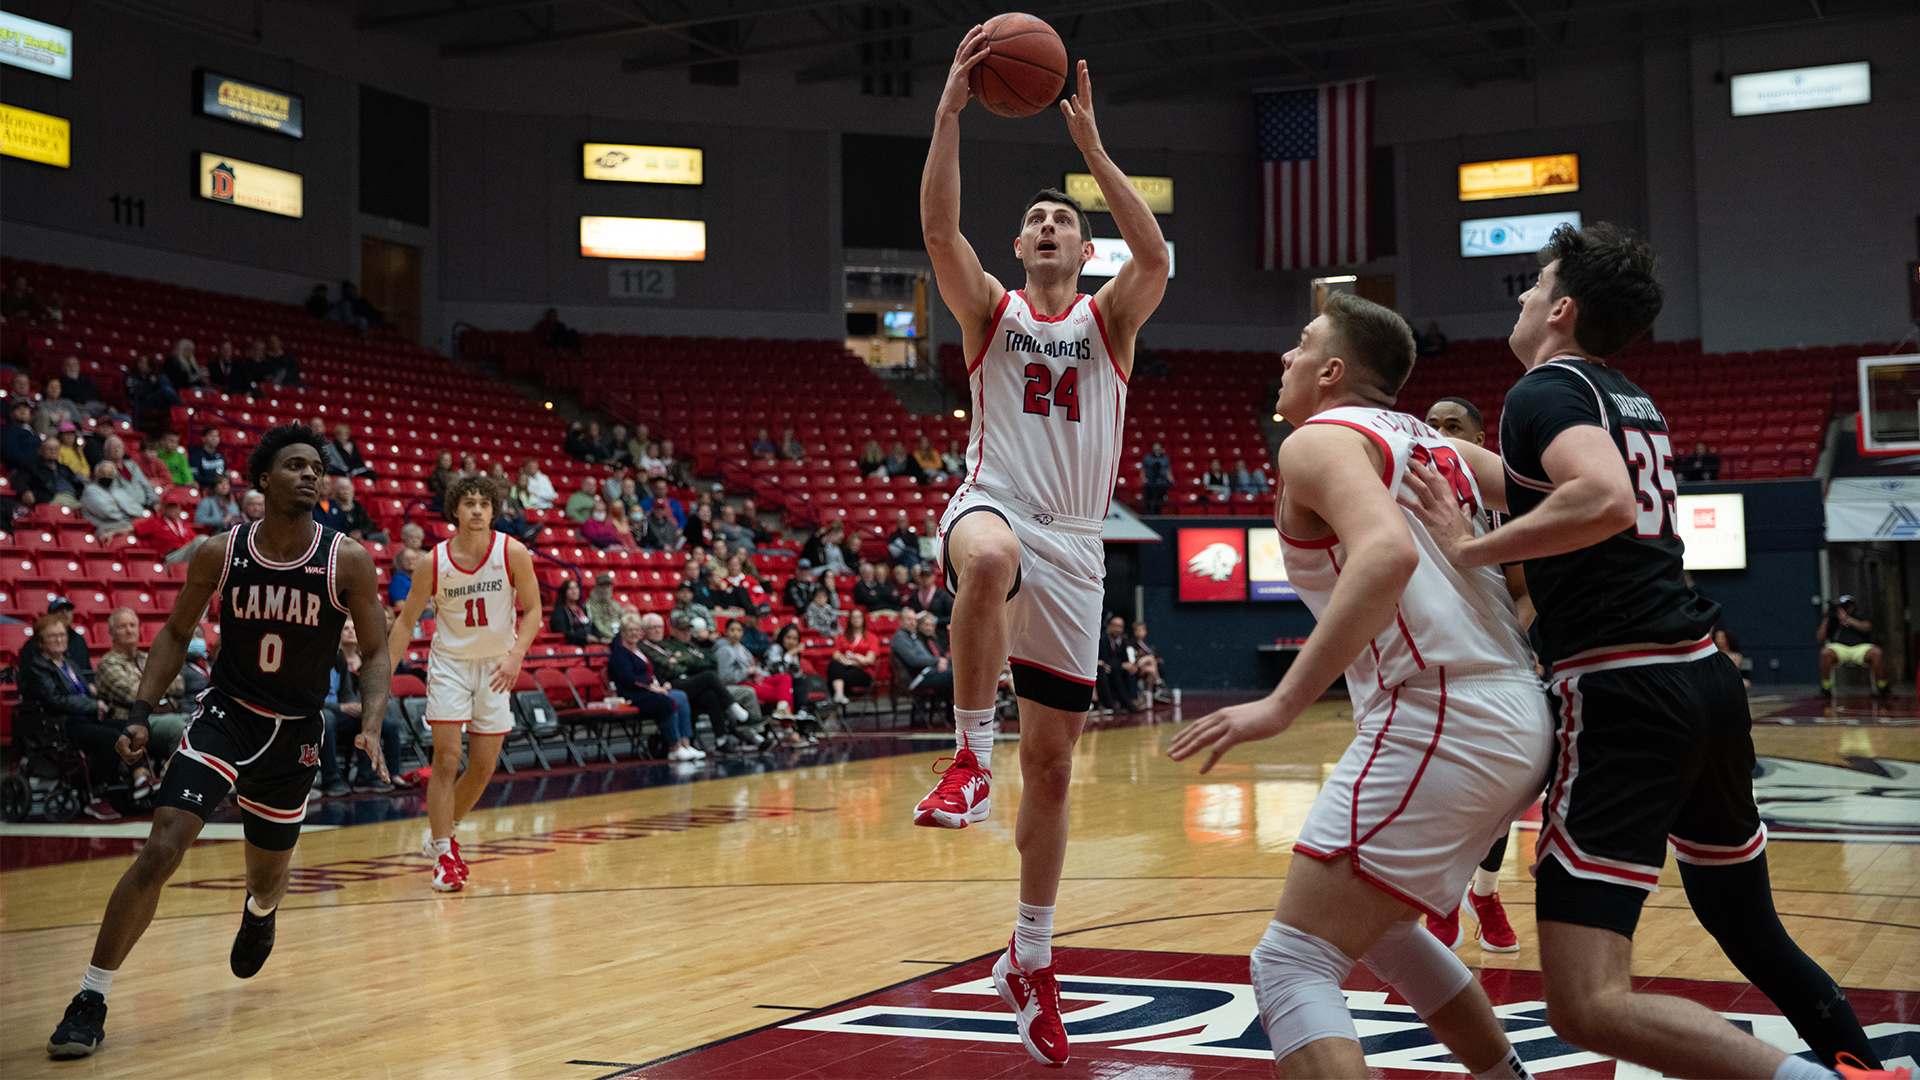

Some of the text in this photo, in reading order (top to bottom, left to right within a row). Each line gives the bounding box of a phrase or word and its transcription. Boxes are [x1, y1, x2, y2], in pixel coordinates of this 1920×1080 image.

[4, 129, 60, 153] AMERICA
[211, 168, 234, 200] D
[109, 194, 145, 228] 111
[1464, 223, 1526, 248] ZION
[619, 268, 665, 294] 112
[1502, 271, 1541, 297] 11
[1005, 329, 1091, 360] TRAILBLAZRS
[1023, 362, 1081, 423] 24
[1622, 426, 1681, 539] 35
[304, 565, 327, 575] WAC
[443, 578, 503, 599] TRAILBLAZERS
[231, 584, 322, 627] LAMAR
[464, 597, 489, 628] 11
[257, 632, 285, 674] 0
